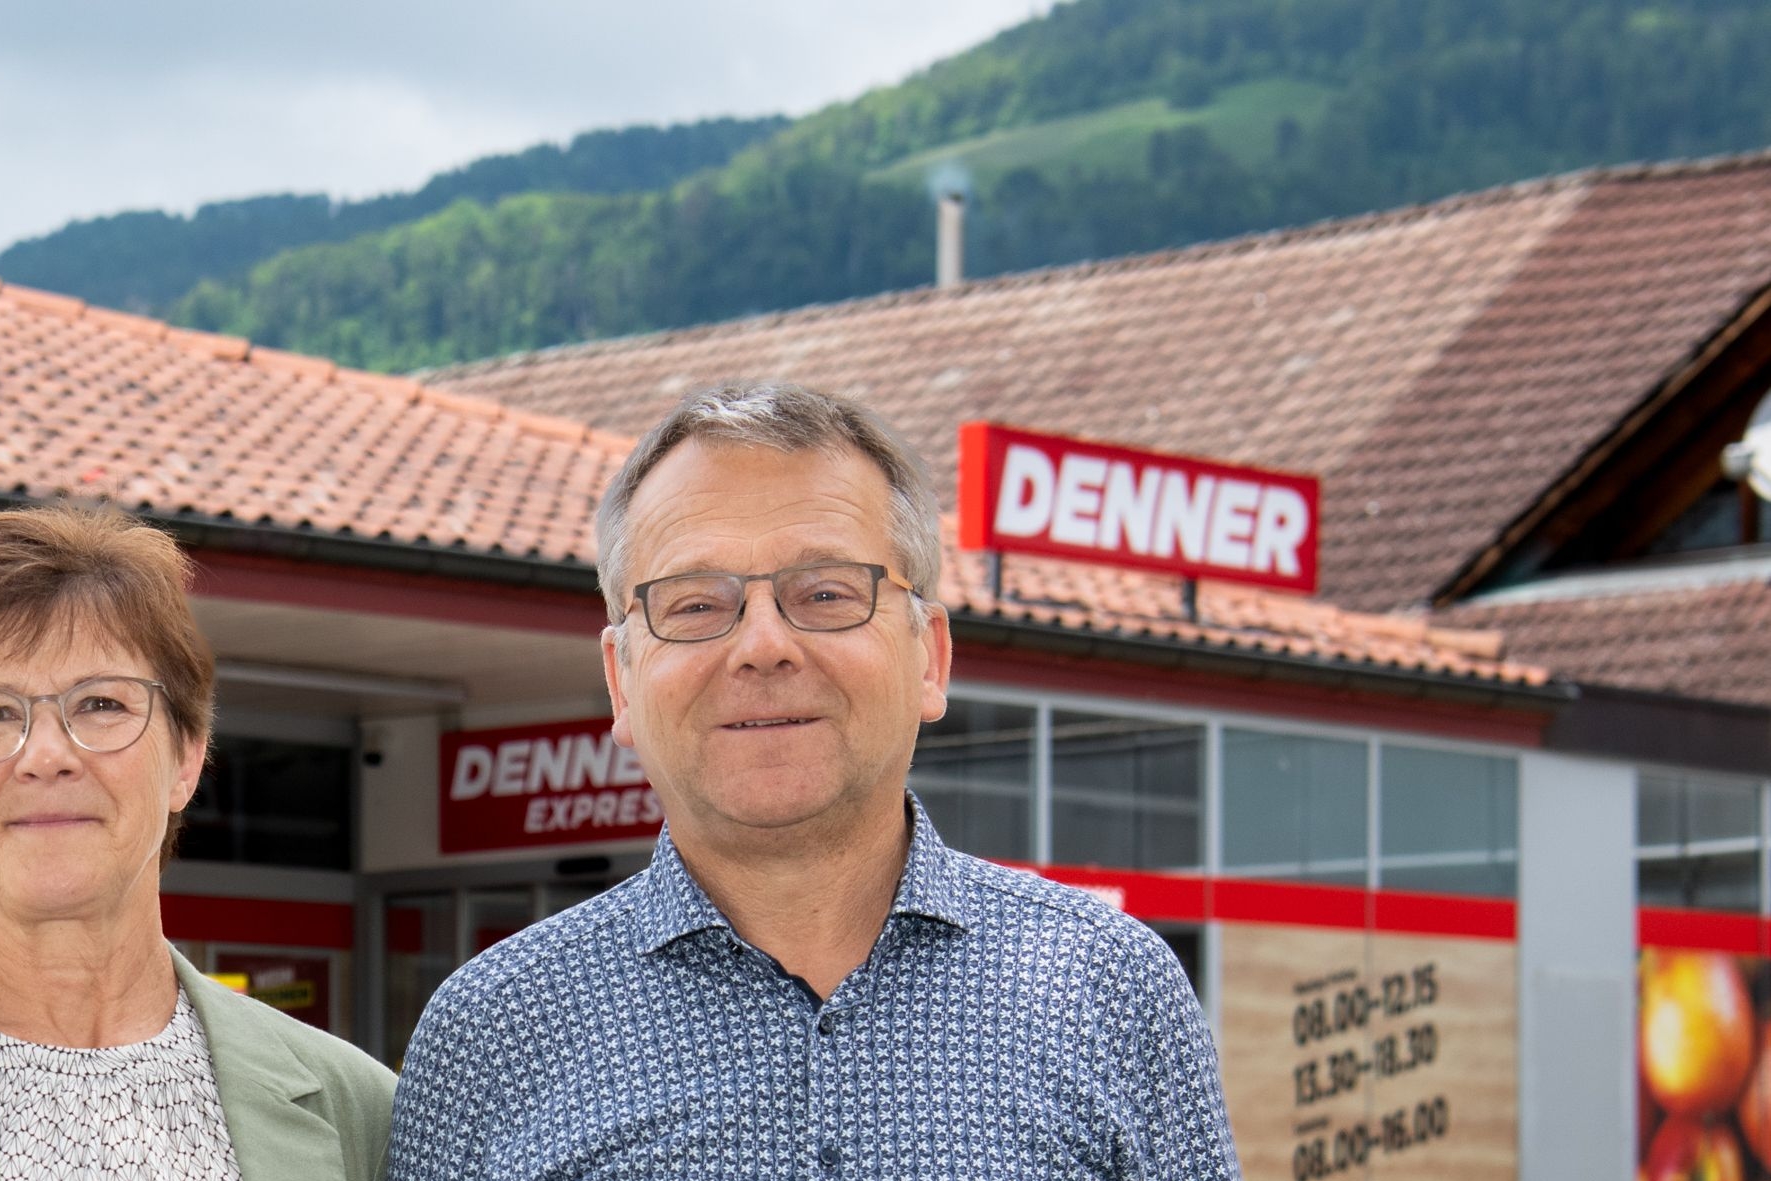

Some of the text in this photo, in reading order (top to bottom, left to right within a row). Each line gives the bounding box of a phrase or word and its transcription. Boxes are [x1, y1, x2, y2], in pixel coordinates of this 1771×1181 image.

[994, 444, 1309, 576] DENNER
[449, 732, 645, 800] DENNE
[524, 789, 666, 833] EXPRES
